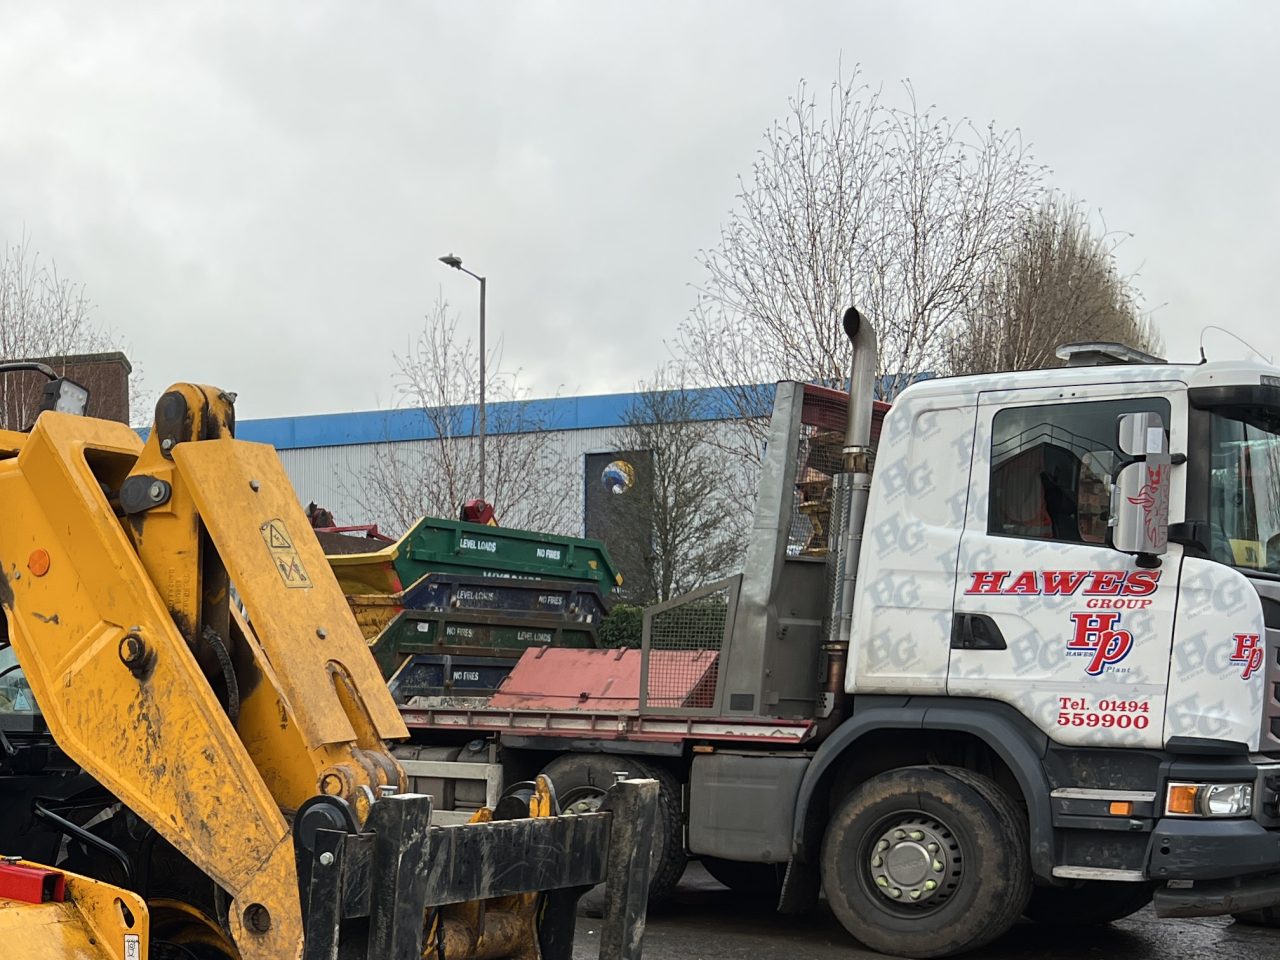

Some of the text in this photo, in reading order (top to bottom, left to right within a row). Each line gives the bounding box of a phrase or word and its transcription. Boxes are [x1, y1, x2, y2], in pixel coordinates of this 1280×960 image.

[460, 539, 497, 553] LEVEL LOADS
[536, 548, 560, 560] NO FIRES
[963, 570, 1162, 596] HAWES
[456, 590, 473, 600] LEVEL
[539, 595, 563, 605] NO FIRES
[1086, 598, 1153, 610] GROUP
[446, 627, 456, 636] NO
[517, 631, 552, 643] LEVEL LOADS
[453, 671, 479, 681] NO FIRES
[1059, 697, 1150, 713] Tel. 01494
[1057, 712, 1149, 730] 559900
